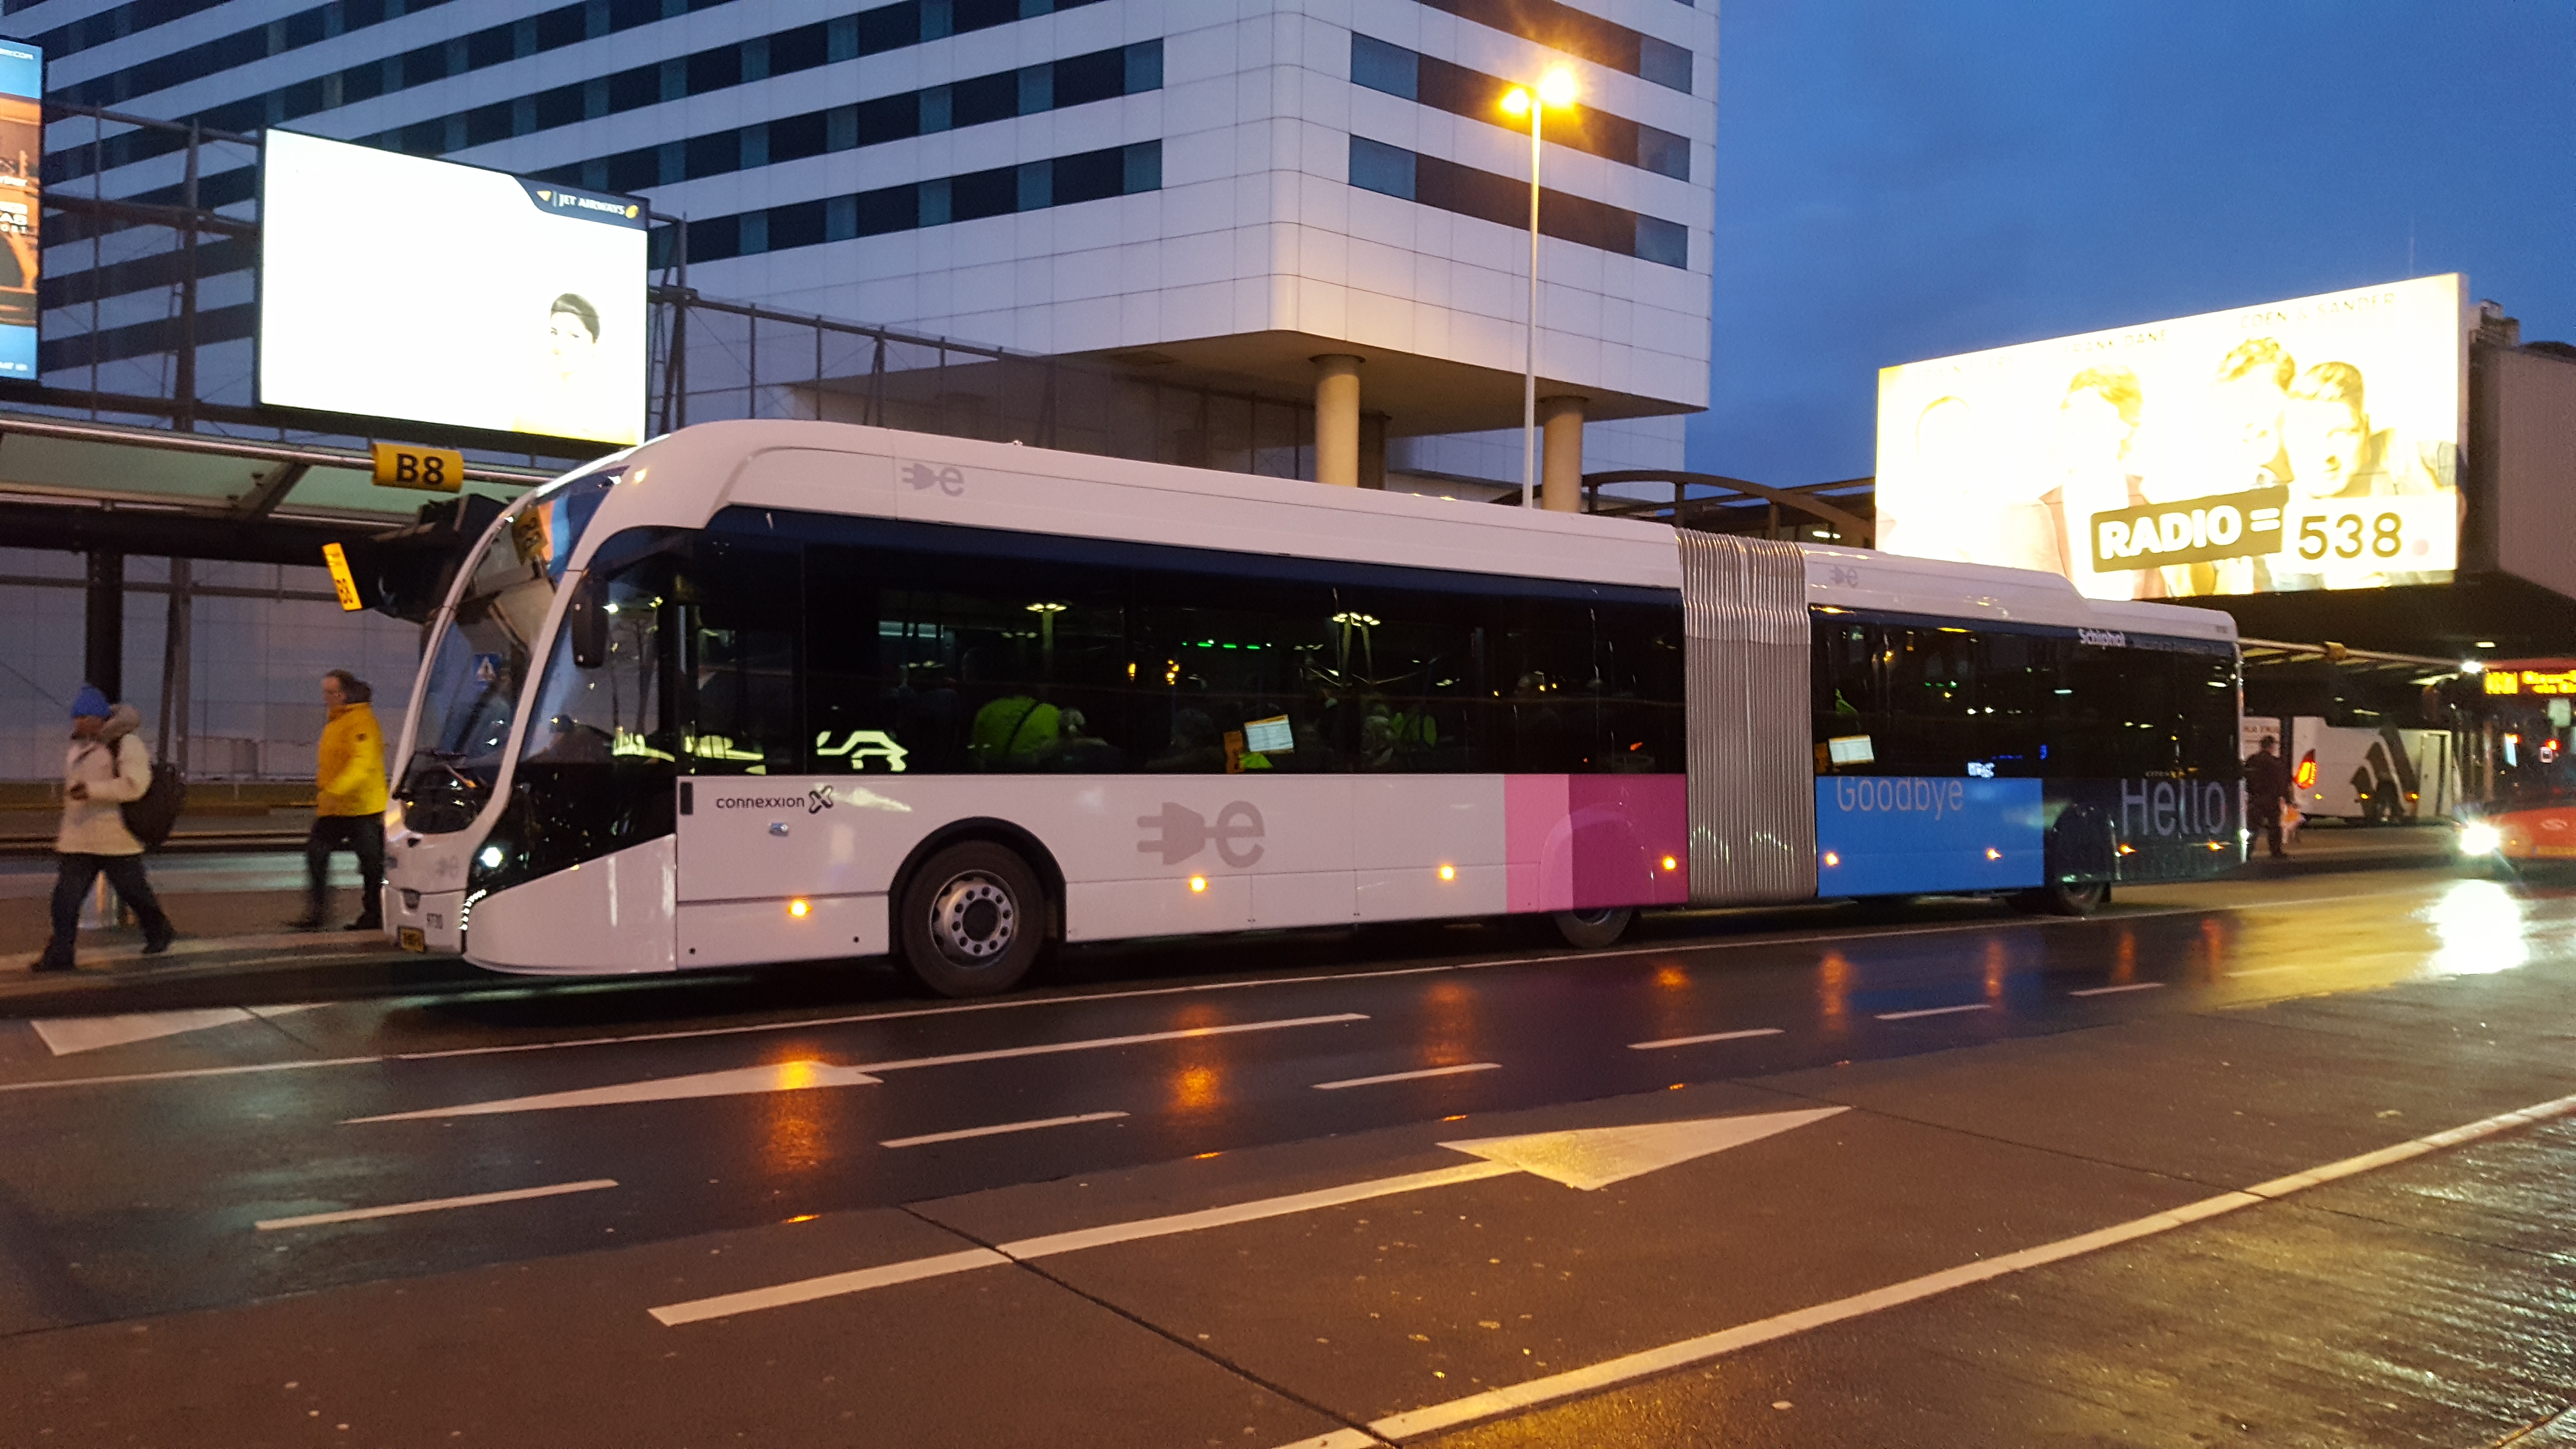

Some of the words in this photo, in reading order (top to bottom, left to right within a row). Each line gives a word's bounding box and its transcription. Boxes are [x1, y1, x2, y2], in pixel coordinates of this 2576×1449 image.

[558, 193, 577, 207] JET
[578, 197, 626, 215] AIRWAYS
[2240, 310, 2287, 329] COEN
[2317, 293, 2395, 315] SANDER
[2125, 328, 2167, 348] DANE
[1915, 365, 1963, 382] EDWN
[396, 452, 445, 485] B8
[2097, 504, 2242, 560] RADIO
[2298, 511, 2403, 561] 538
[716, 797, 805, 809] connexxion
[1836, 776, 1963, 821] Goodbye
[2120, 777, 2226, 836] Hello
